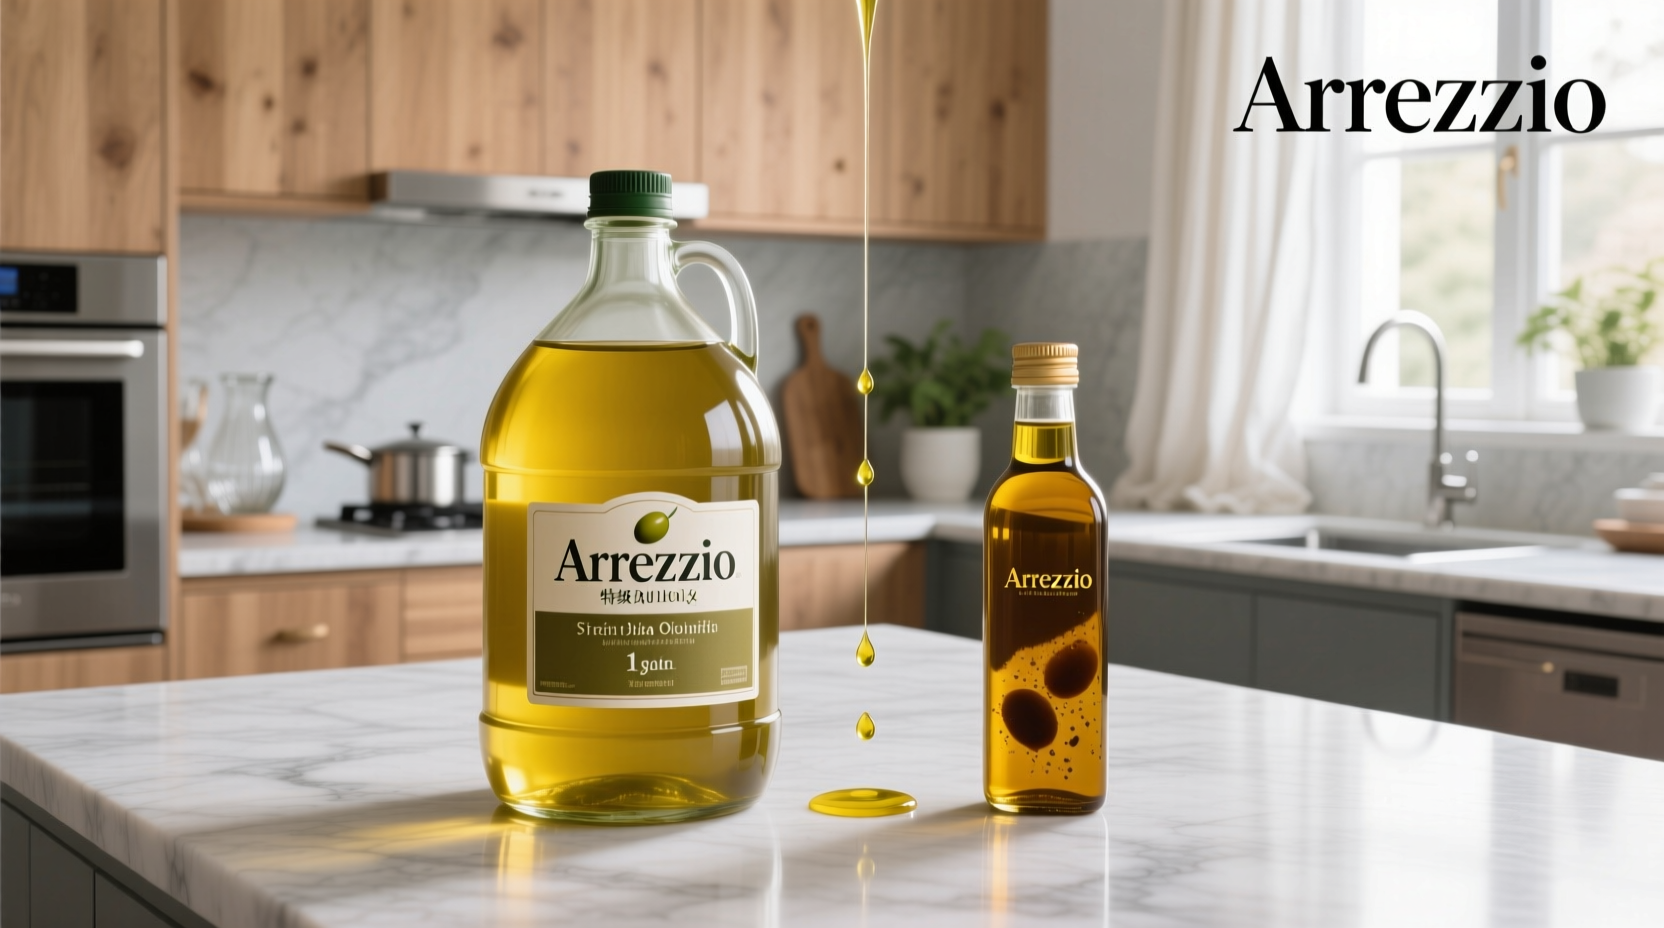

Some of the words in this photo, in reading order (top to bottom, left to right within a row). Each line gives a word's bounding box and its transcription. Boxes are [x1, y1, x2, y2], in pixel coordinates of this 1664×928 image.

[554, 538, 736, 583] Arrezzio
[1004, 567, 1093, 589] Arrezzio
[626, 651, 638, 672] 1
